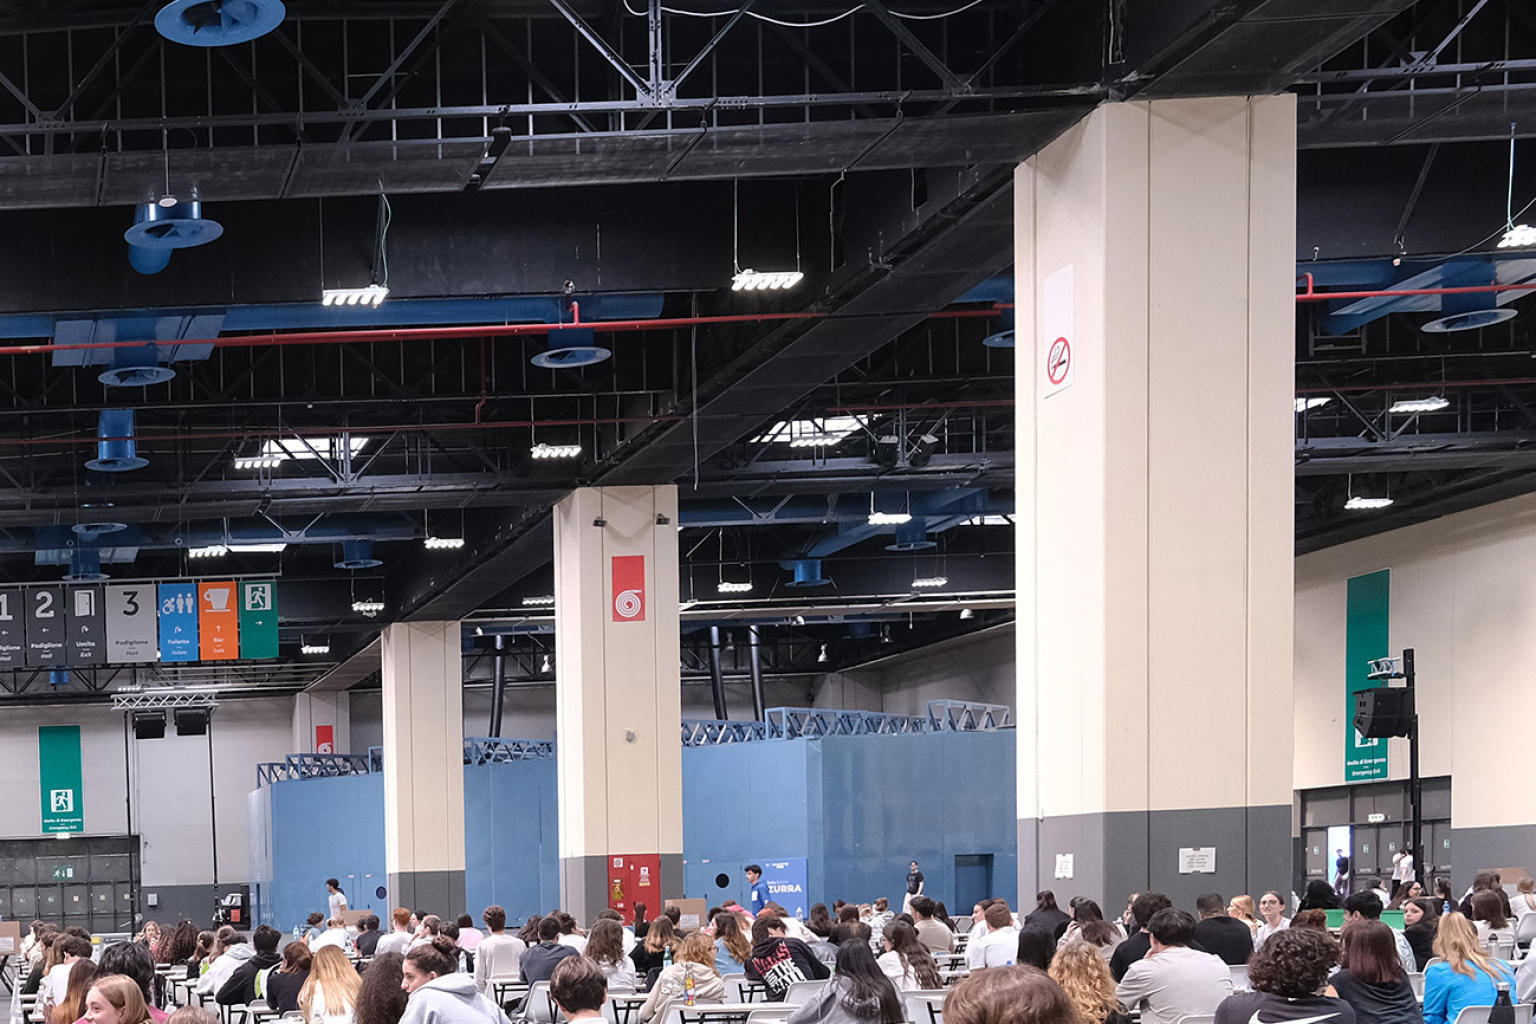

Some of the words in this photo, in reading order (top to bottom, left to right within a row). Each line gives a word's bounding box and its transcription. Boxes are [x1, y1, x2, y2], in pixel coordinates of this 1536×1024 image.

[35, 591, 54, 618] 2
[122, 590, 139, 616] 3
[768, 884, 802, 894] ZURRA
